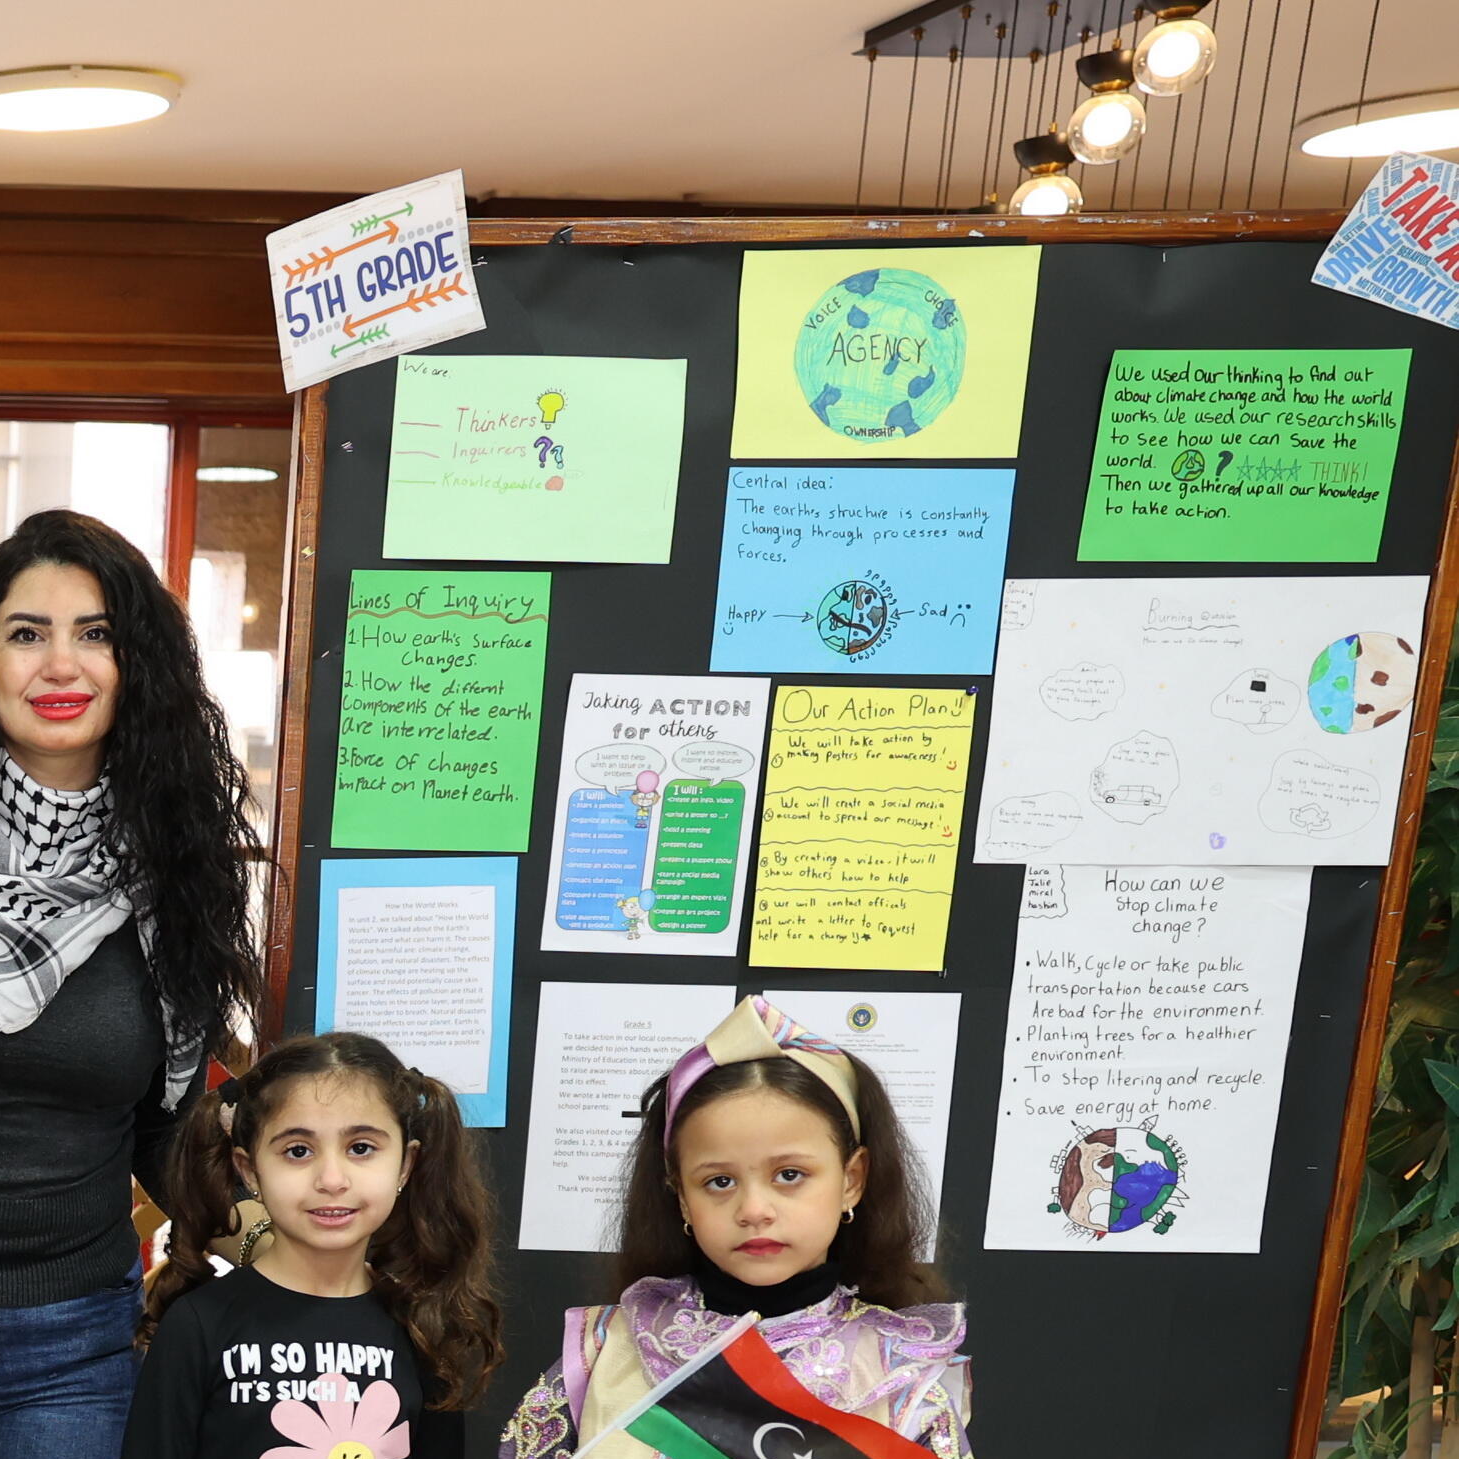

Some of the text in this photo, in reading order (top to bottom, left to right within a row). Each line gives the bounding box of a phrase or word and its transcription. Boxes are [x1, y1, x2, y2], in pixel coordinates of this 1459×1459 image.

[1381, 167, 1459, 251] TAKE
[1323, 217, 1401, 285] DRIVE
[285, 232, 459, 338] 5TH GRADE
[1356, 277, 1397, 304] MOTIVATION
[1372, 255, 1459, 318] GROWTH
[805, 297, 842, 331] VOICE
[924, 290, 959, 328] CHOICE
[827, 332, 927, 366] AGENCY
[403, 361, 430, 376] We
[1115, 361, 1373, 392] We used our thinking to find out
[1114, 385, 1393, 410] about climate change and how the world
[457, 406, 538, 433] Thinkers
[1111, 408, 1397, 429] works. We used our research skills
[844, 425, 896, 438] OWNERSHIP
[1110, 432, 1129, 446] to
[1137, 433, 1169, 447] see
[1177, 430, 1213, 447] how
[1221, 433, 1242, 445] we
[1249, 434, 1281, 446] can
[1333, 433, 1358, 449] the
[452, 442, 527, 463] Inquirers
[1106, 454, 1156, 470] world.
[442, 473, 542, 494] Knowledgeable
[733, 471, 834, 490] Central idea:
[1101, 473, 1141, 492] Then
[1148, 479, 1172, 493] we
[1179, 477, 1243, 498] gathered
[1246, 484, 1264, 497] up
[1265, 481, 1284, 497] all
[1289, 485, 1315, 497] our
[737, 498, 765, 515] The
[829, 506, 888, 521] structure
[900, 507, 913, 520] is
[921, 504, 990, 523] constantly
[1105, 501, 1231, 519] to take action.
[812, 525, 864, 541] through
[873, 526, 948, 545] processes
[957, 525, 984, 541] and
[350, 582, 534, 624] Lines of Inquiry
[728, 604, 947, 622] Happy Sad
[362, 625, 406, 648] How
[412, 631, 461, 647] earth's
[362, 672, 402, 691] How
[410, 676, 431, 693] the
[460, 700, 480, 717] the
[488, 703, 531, 720] earth
[583, 691, 751, 717] Taking ACTION
[783, 689, 948, 723] Our Action Plan
[613, 720, 718, 740] for others
[1105, 870, 1225, 893] How can we
[1155, 897, 1218, 912] climate
[1132, 917, 1207, 944] change?
[1036, 950, 1082, 974] Walk,
[1131, 959, 1148, 972] or
[1156, 957, 1190, 974] take
[1198, 958, 1244, 976] public
[1027, 975, 1249, 999] transportation because cars
[1032, 999, 1265, 1019] Are bad for the environment.
[1027, 1025, 1257, 1047] Planting trees for a healthier
[1031, 1048, 1126, 1062] environment.
[1025, 1065, 1266, 1095] To stop litering and recycle.
[1024, 1096, 1218, 1123] Save energy at home.
[223, 1342, 394, 1380] I'M SO HAPPY
[231, 1380, 362, 1403] IT'S SUCH A
